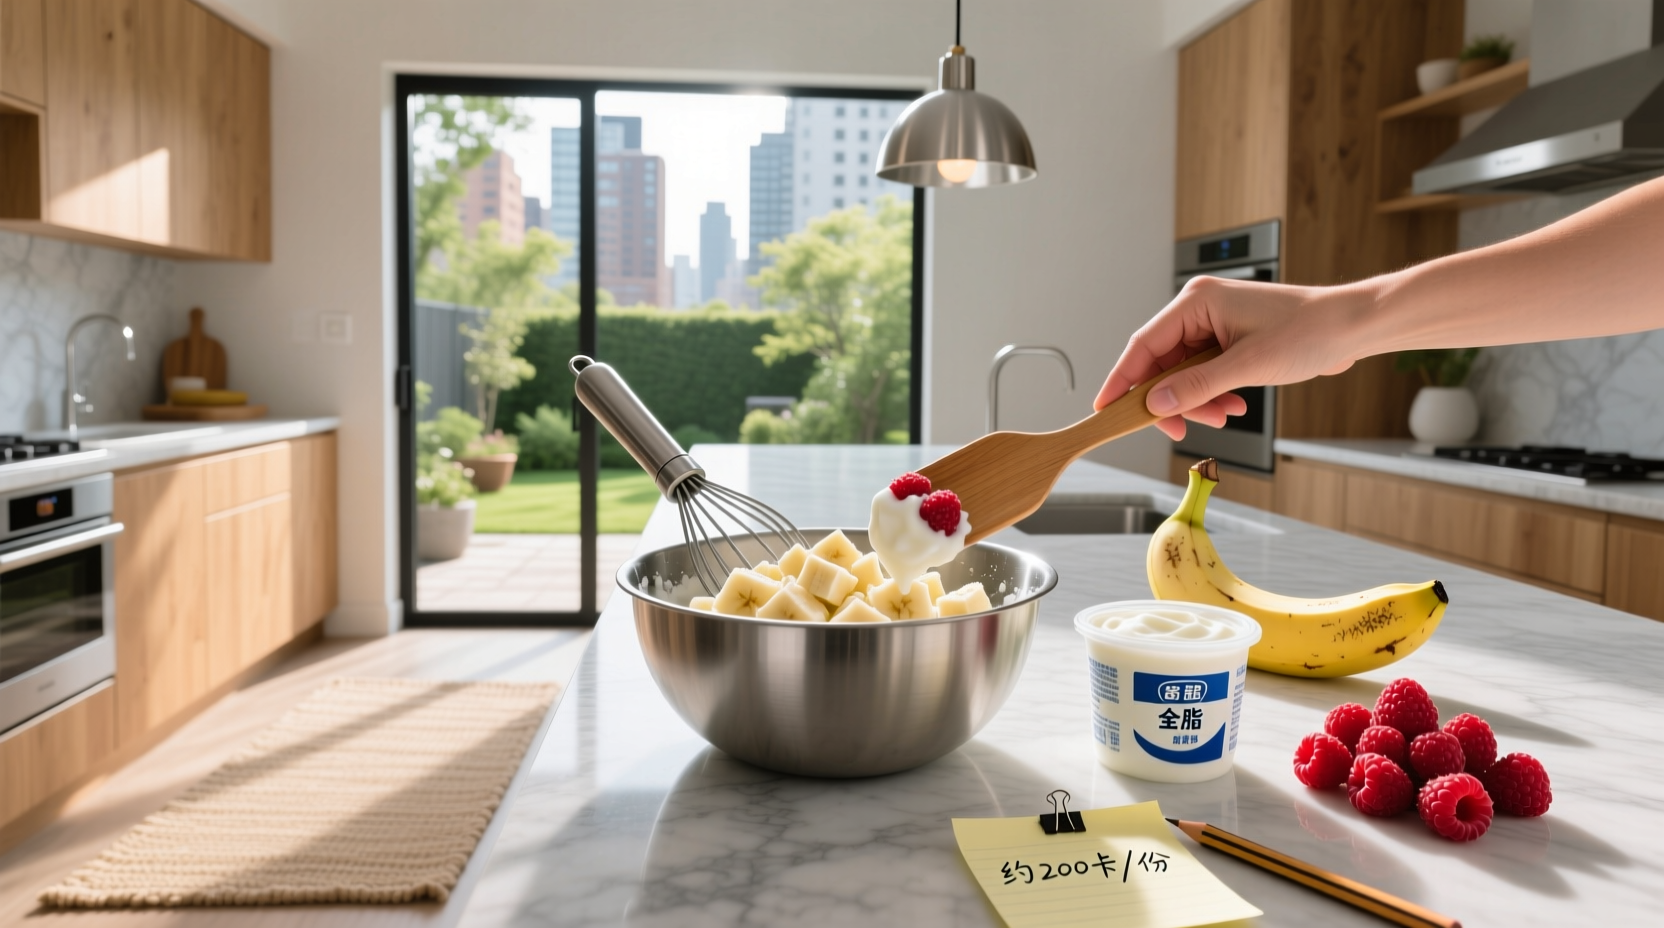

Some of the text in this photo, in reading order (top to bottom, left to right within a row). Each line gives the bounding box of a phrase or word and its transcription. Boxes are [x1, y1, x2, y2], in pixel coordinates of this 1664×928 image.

[1158, 707, 1203, 731] 全脂
[1000, 850, 1171, 885] 约200卡/份
